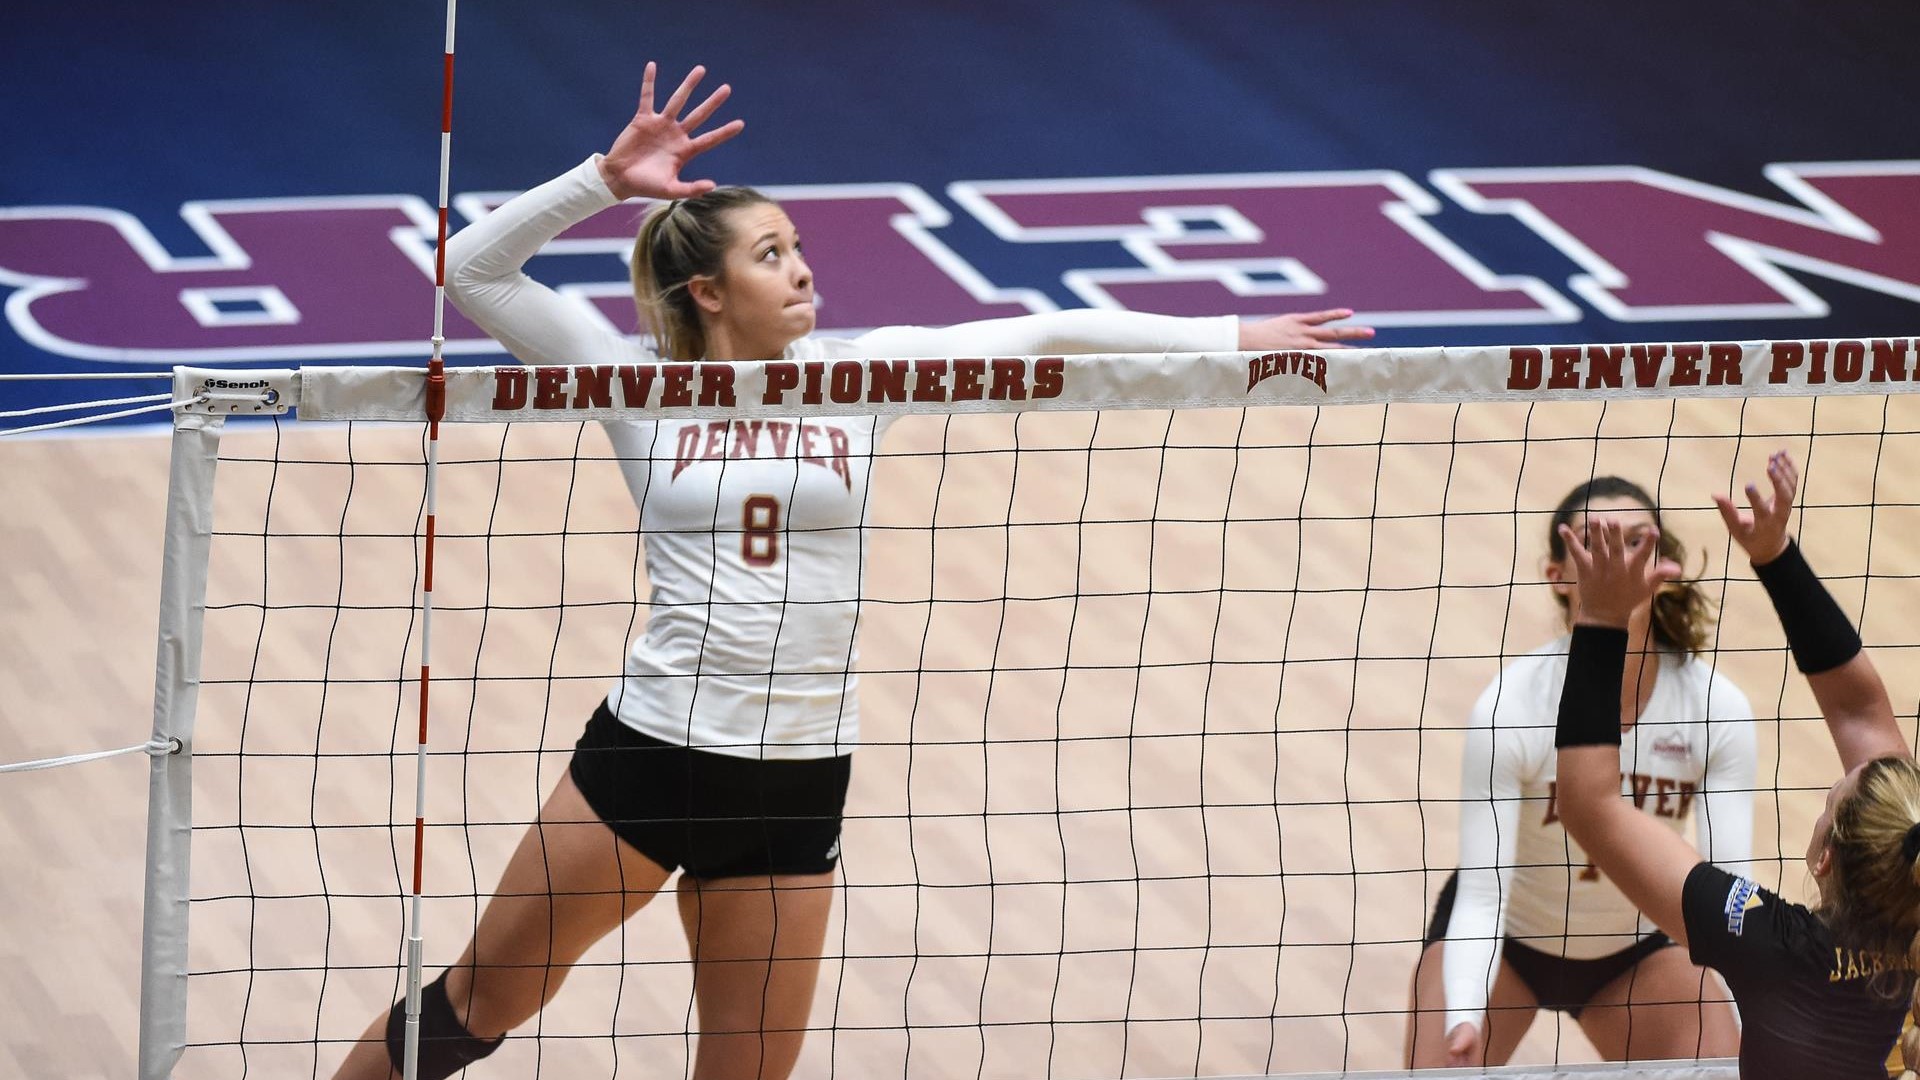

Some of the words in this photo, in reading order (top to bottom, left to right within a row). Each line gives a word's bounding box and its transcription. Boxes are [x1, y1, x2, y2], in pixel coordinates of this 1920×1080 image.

[216, 380, 270, 389] Senoh
[492, 363, 736, 409] DENVER
[762, 356, 1065, 404] PIONEERS
[1246, 352, 1329, 394] DENVER
[1507, 342, 1743, 389] DENVER
[671, 419, 852, 494] DENVER
[741, 493, 781, 569] 8
